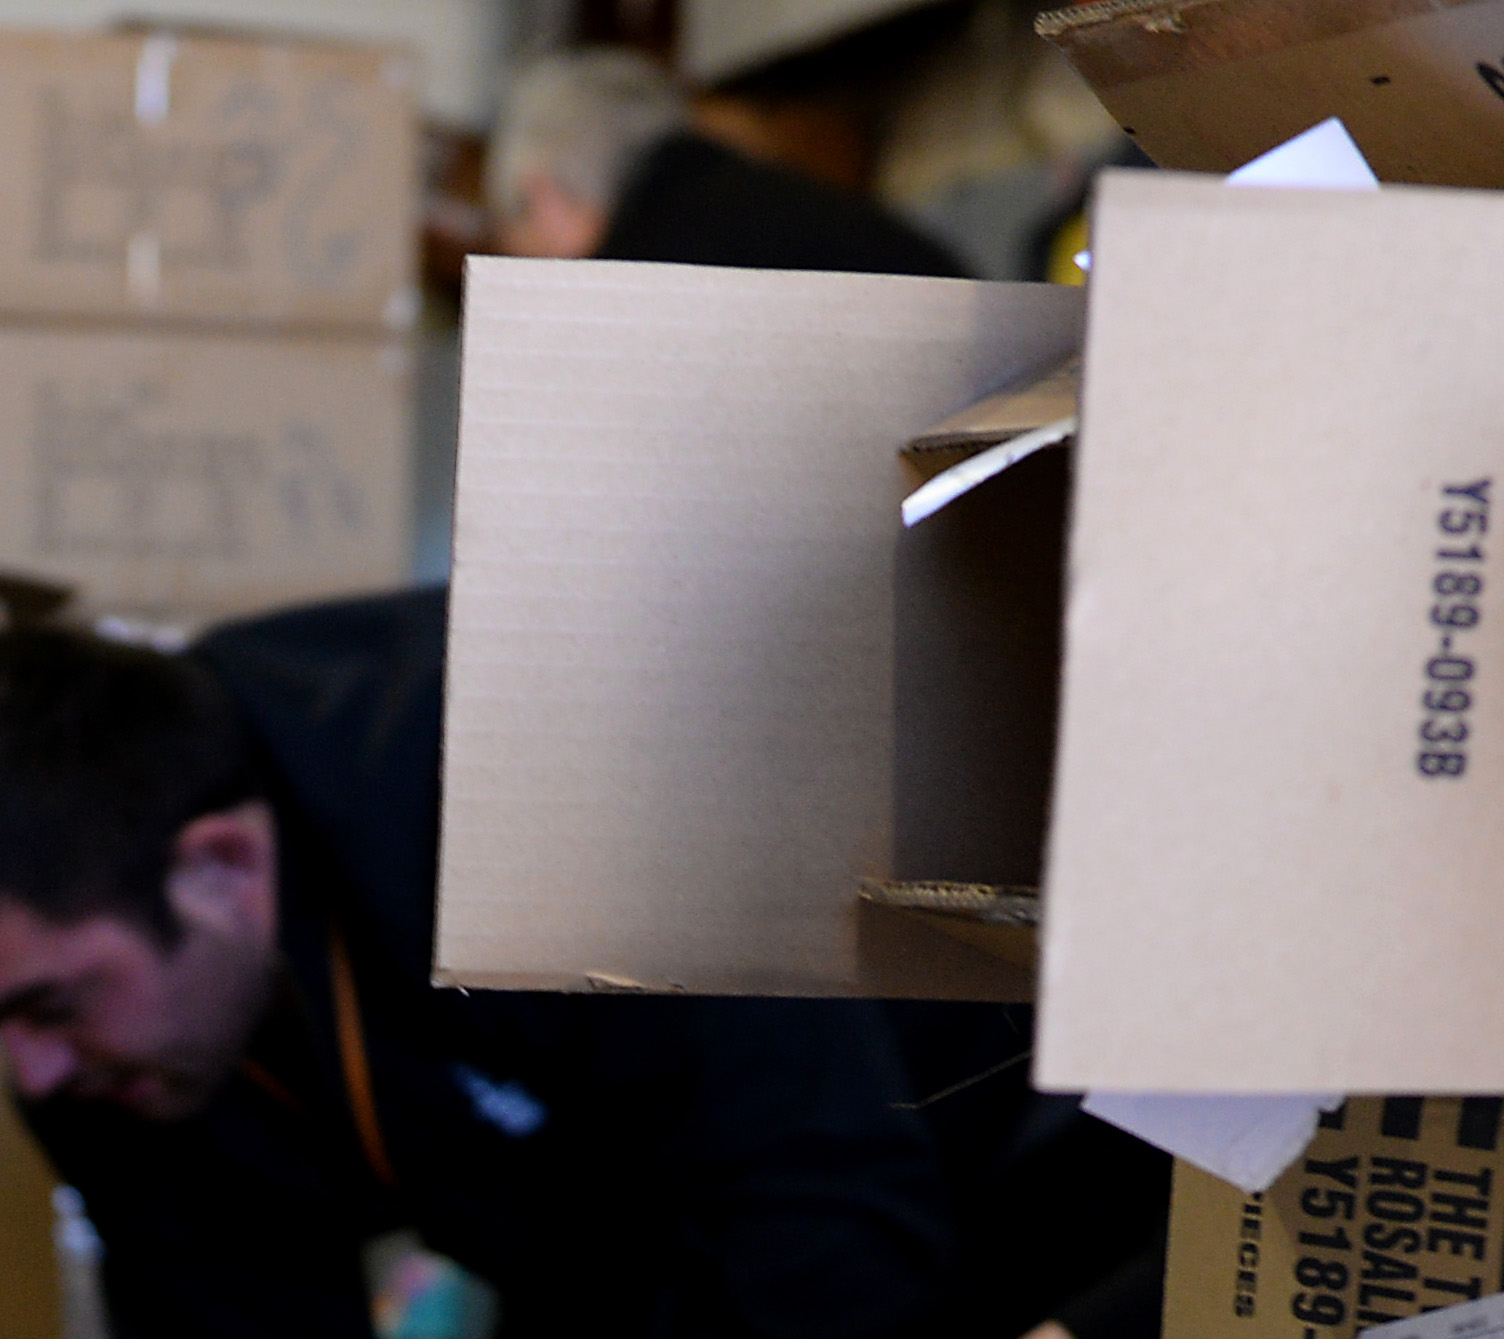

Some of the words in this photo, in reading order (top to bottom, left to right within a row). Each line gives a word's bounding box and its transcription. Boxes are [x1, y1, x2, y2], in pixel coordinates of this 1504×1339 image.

[1417, 475, 1494, 778] Y5189-093B
[1356, 1156, 1428, 1333] ROSALI
[1428, 1168, 1493, 1260] THE
